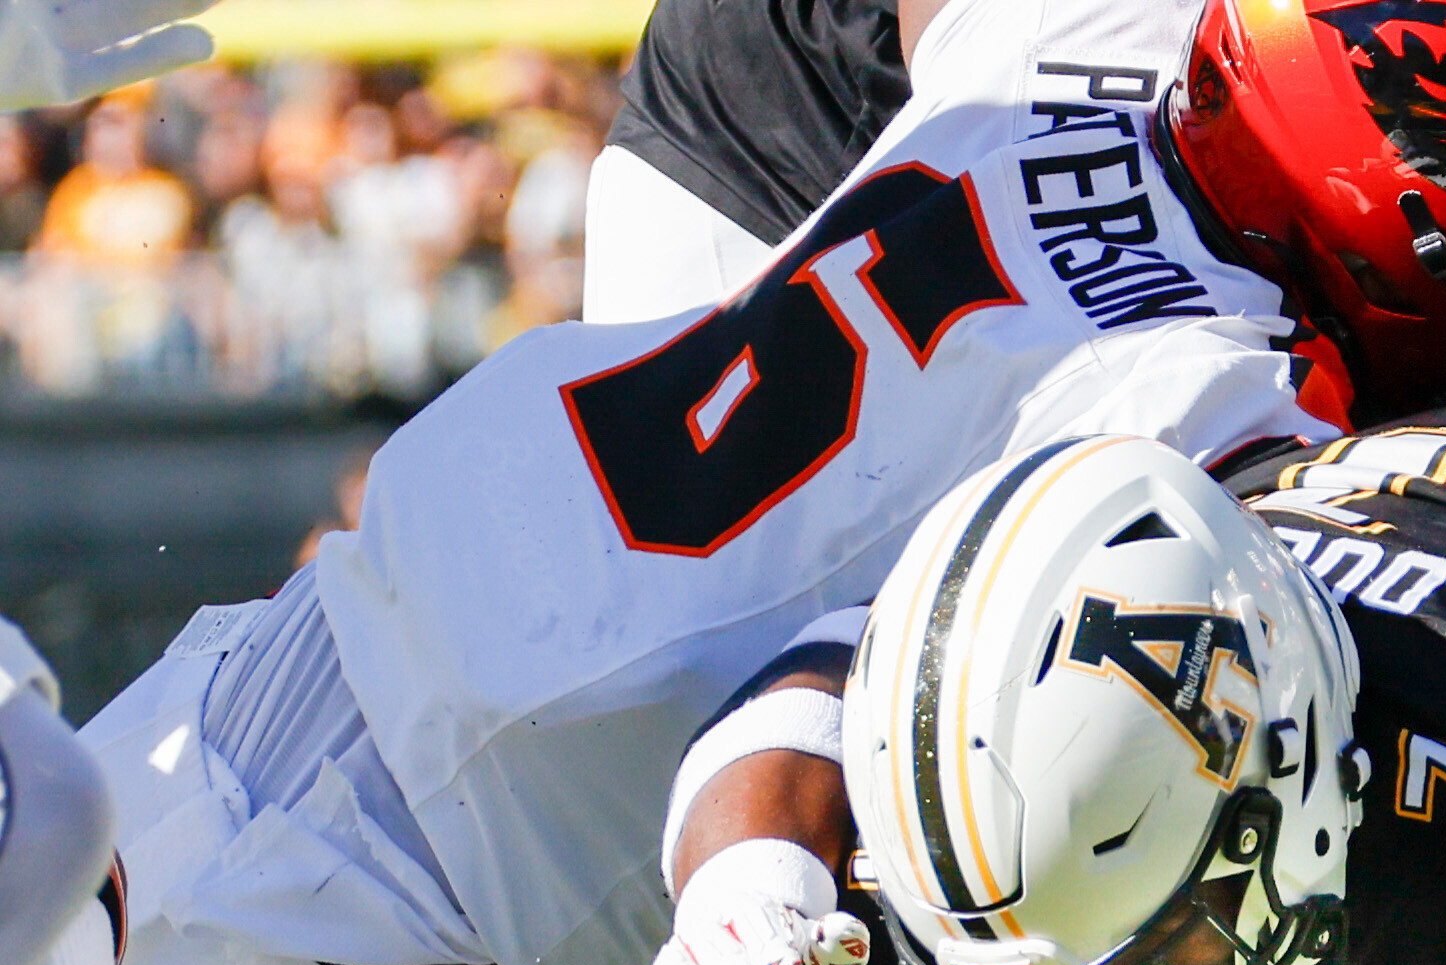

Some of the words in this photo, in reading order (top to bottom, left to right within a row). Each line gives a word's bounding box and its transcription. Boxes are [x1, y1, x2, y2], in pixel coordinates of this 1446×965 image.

[1019, 61, 1219, 330] PATERSON
[558, 160, 1026, 557] 6
[1174, 618, 1215, 711] Mountaineers
